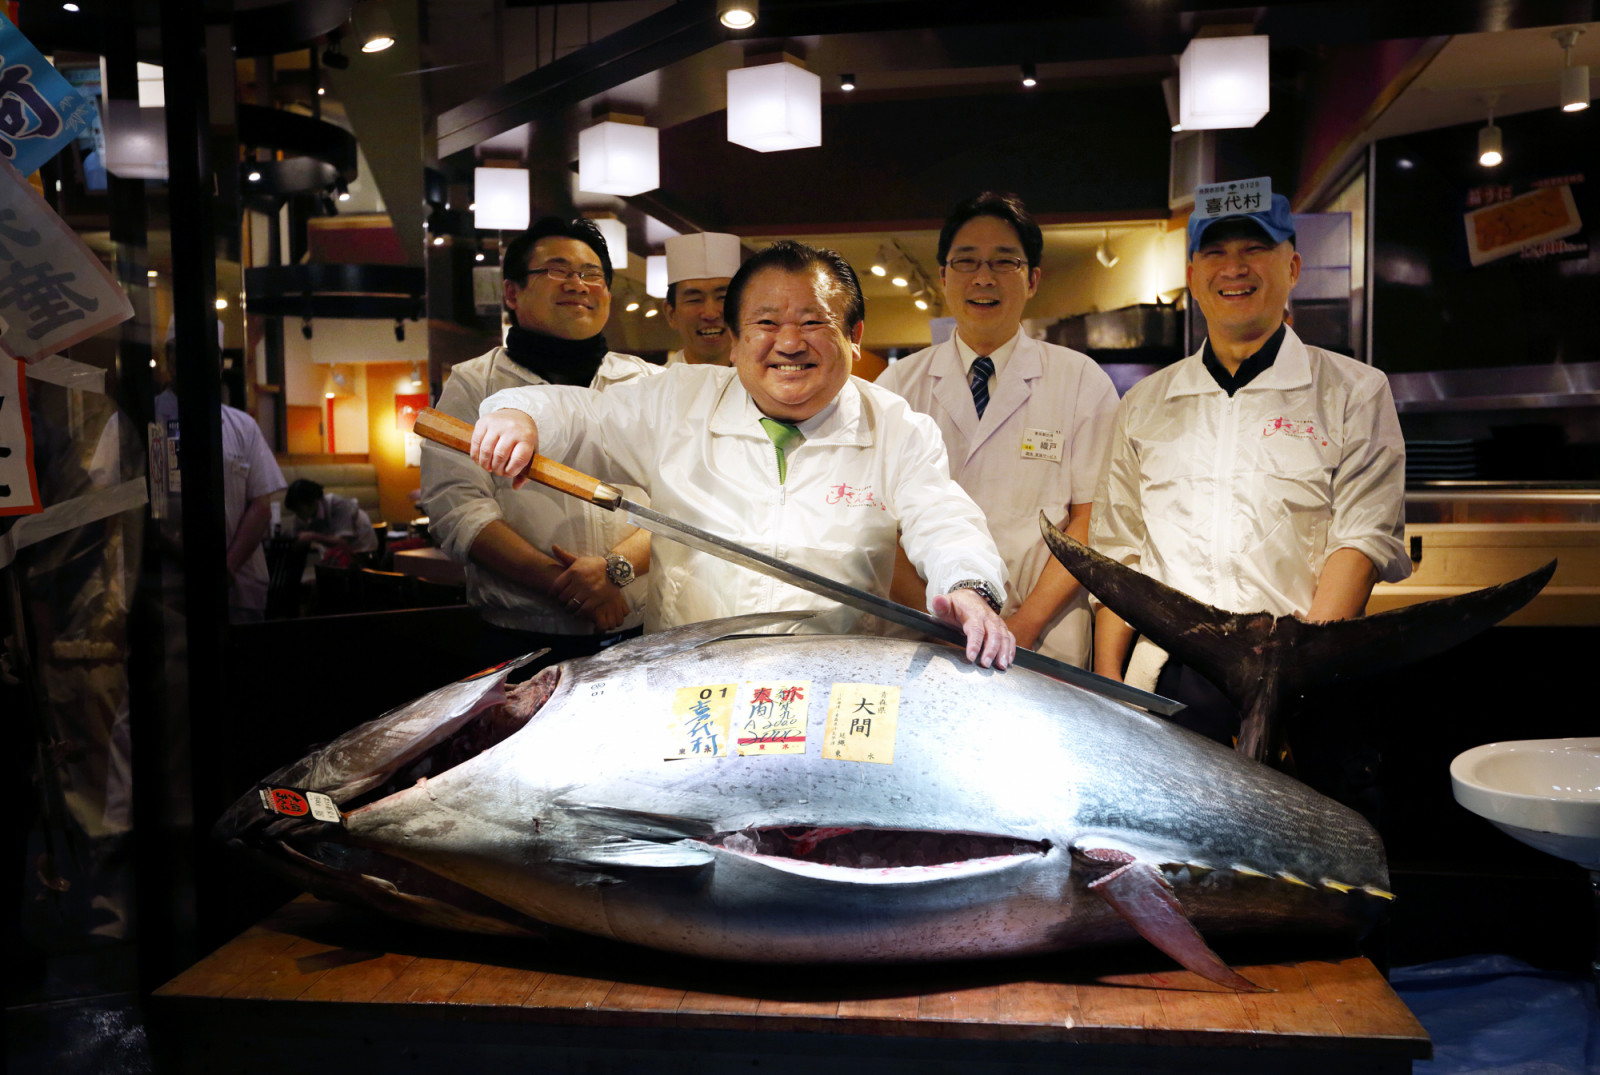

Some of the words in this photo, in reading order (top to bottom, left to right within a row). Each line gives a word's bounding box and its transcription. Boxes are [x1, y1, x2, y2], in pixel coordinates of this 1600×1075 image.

[1205, 192, 1261, 214] 喜代村
[699, 687, 728, 700] 01
[849, 697, 876, 738] 大間
